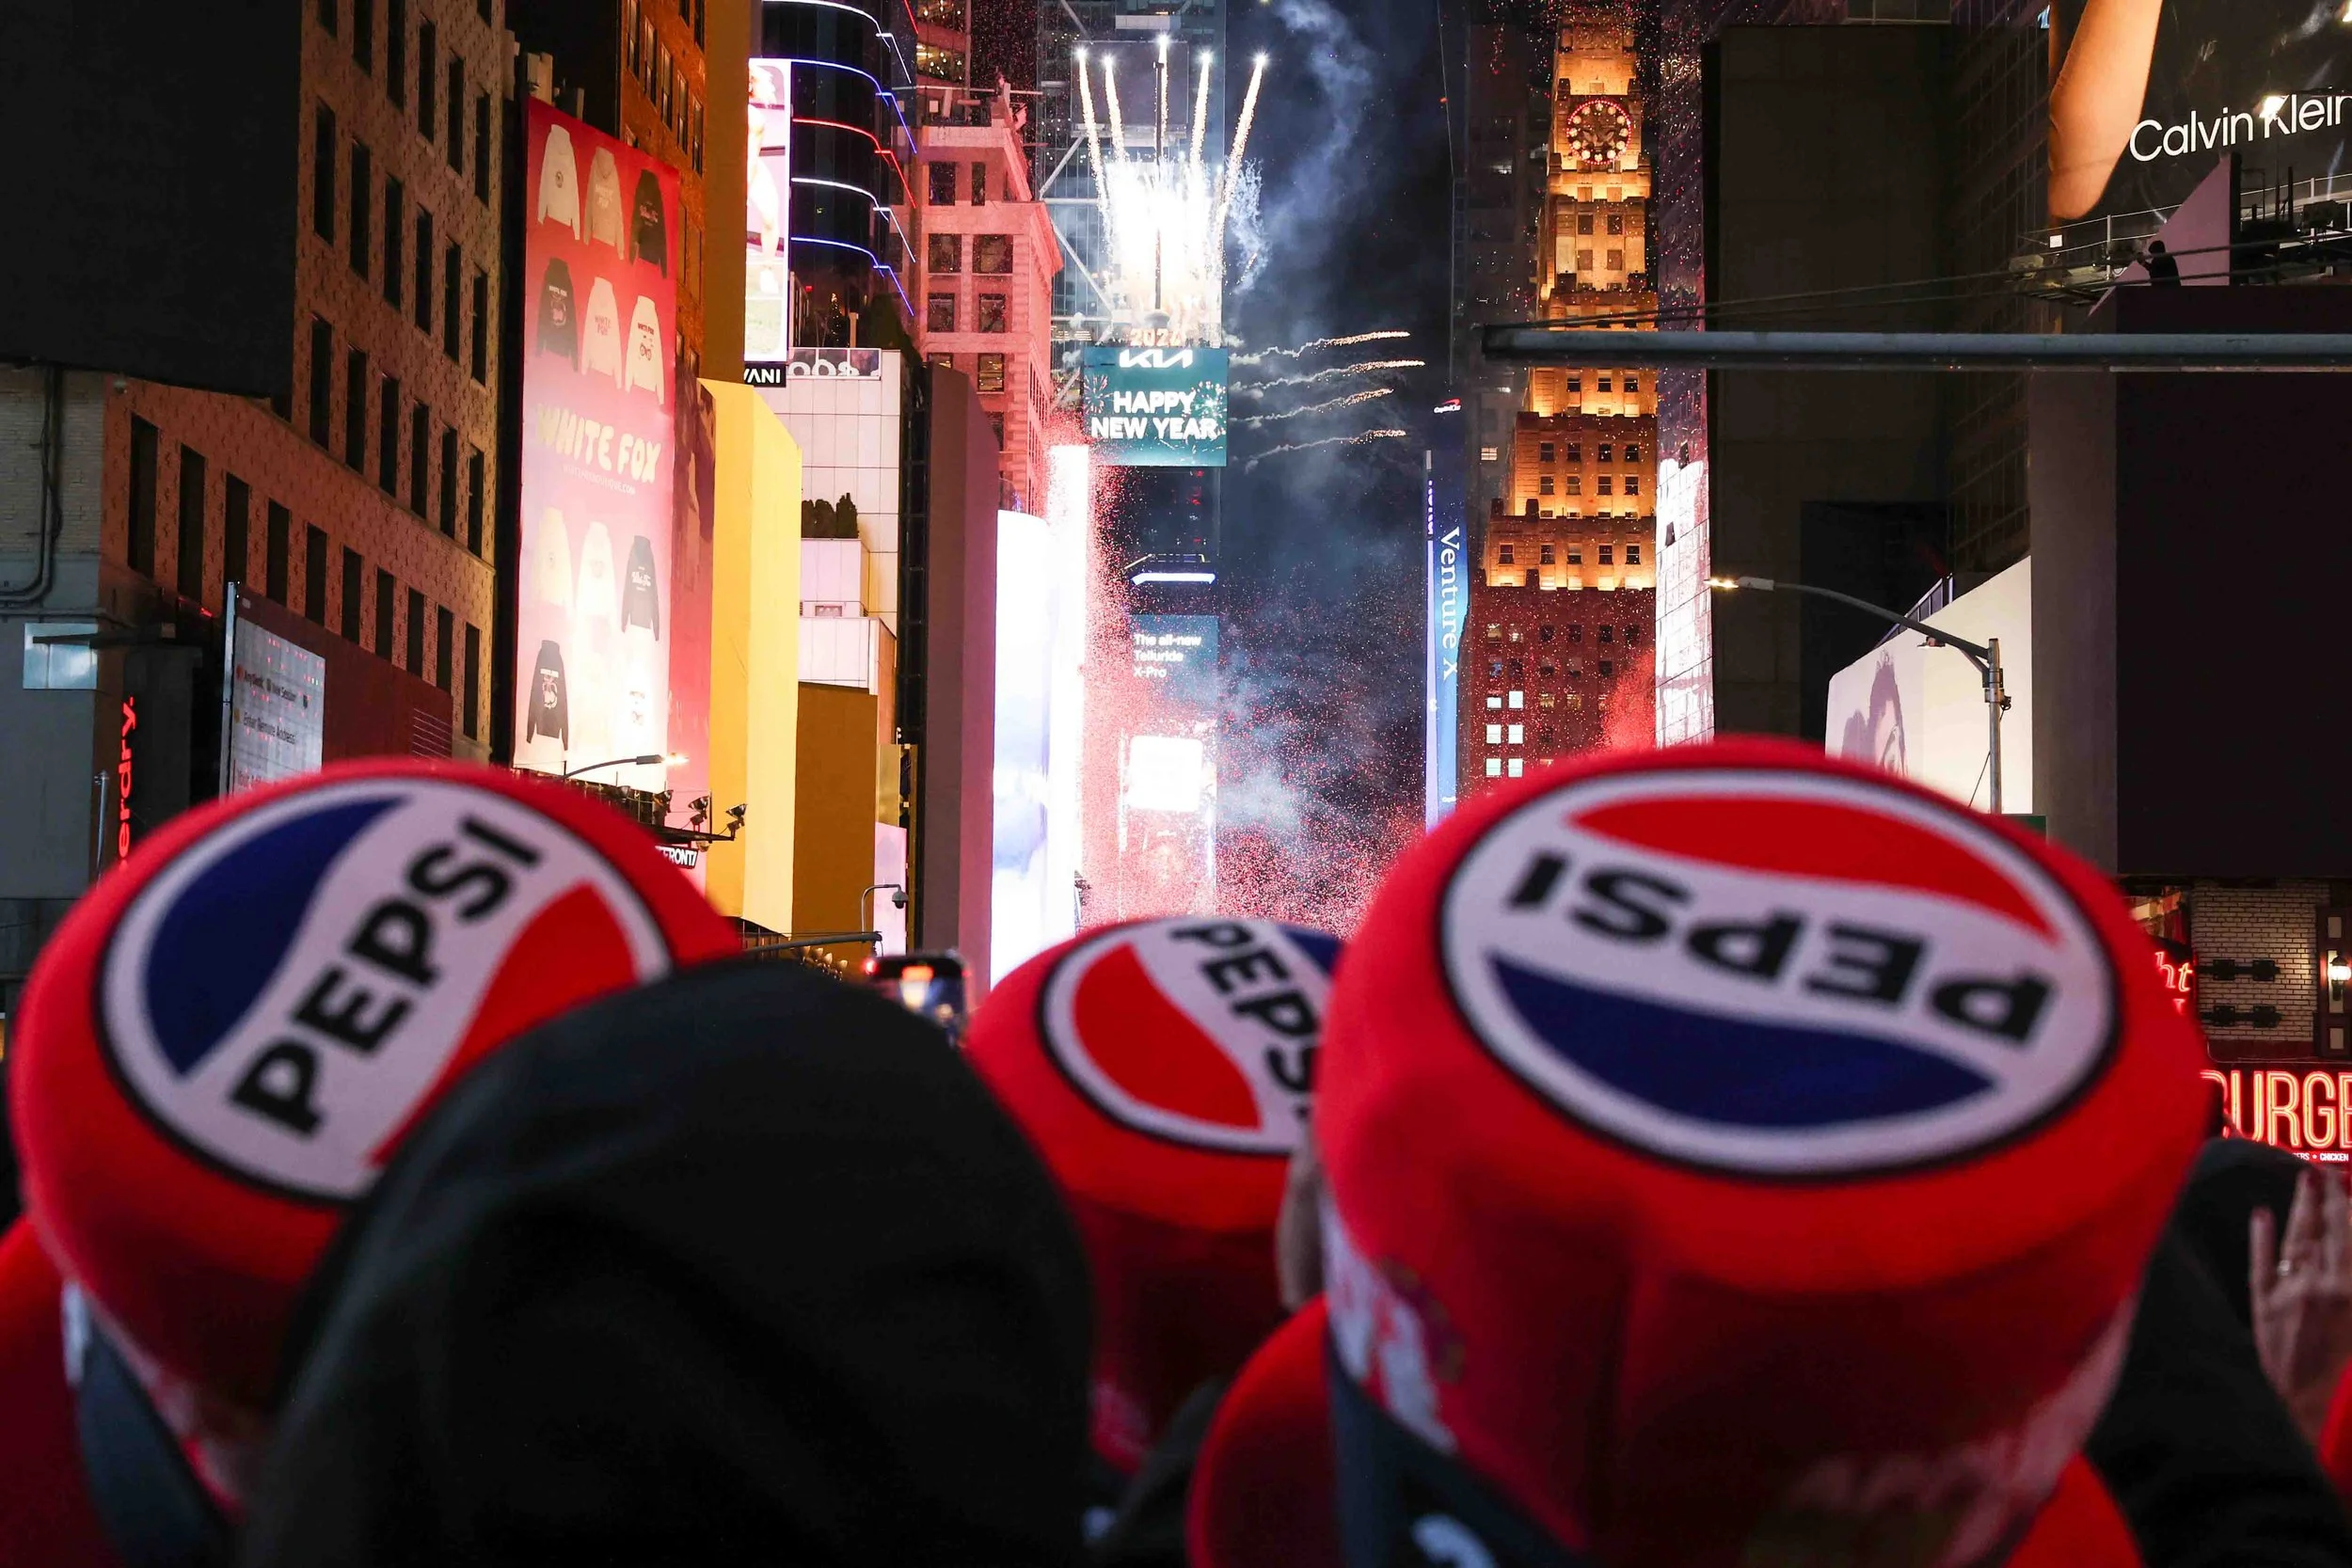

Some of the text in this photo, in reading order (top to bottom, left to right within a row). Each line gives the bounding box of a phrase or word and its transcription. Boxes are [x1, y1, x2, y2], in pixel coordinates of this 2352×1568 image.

[2129, 106, 2254, 162] Calvin
[1091, 417, 1218, 440] NEW YEAR
[1114, 391, 1196, 414] HAPPY
[537, 403, 661, 483] WHITE FOX
[1439, 526, 1460, 681] Venture X
[1134, 634, 1201, 646] The all-new
[1134, 666, 1167, 677] X-Pro
[229, 816, 543, 1139] PEPSI
[1505, 852, 2058, 1047] PEPSI
